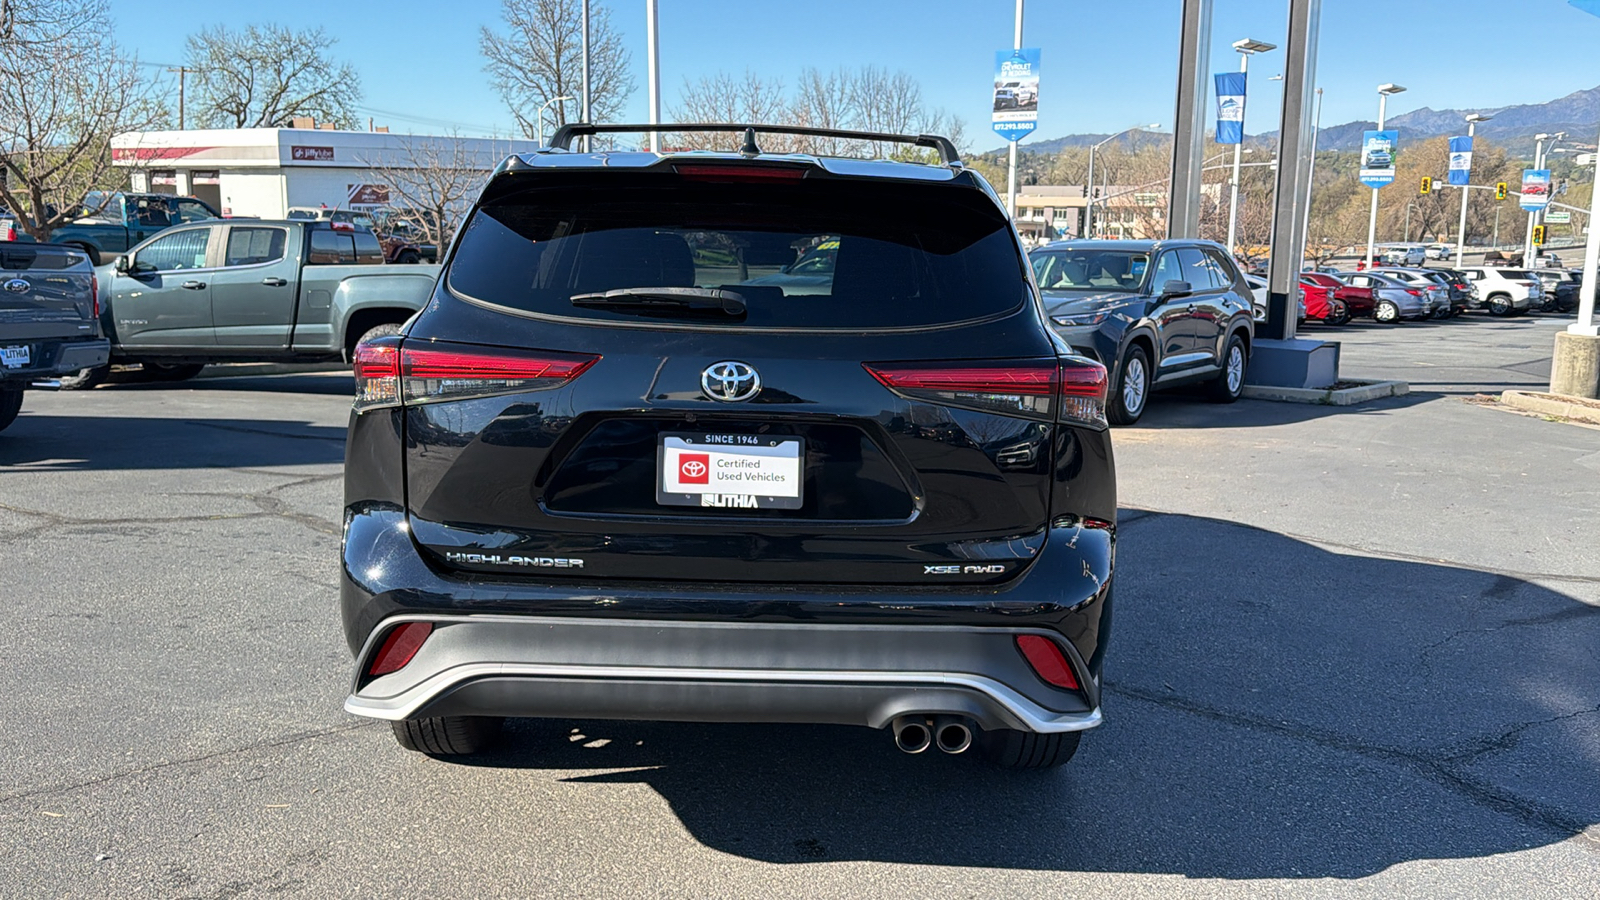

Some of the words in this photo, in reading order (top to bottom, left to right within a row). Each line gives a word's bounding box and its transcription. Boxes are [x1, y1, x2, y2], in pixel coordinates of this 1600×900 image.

[5, 349, 28, 359] LITHIA
[705, 434, 734, 443] SINCE
[737, 435, 758, 444] 1946
[717, 459, 760, 468] Certified
[717, 472, 742, 481] Used
[745, 472, 786, 482] Vehicles
[714, 494, 759, 508] LITHIA
[446, 552, 584, 568] HIGHLANDER
[924, 565, 960, 574] XSE
[964, 565, 1005, 574] AWD
